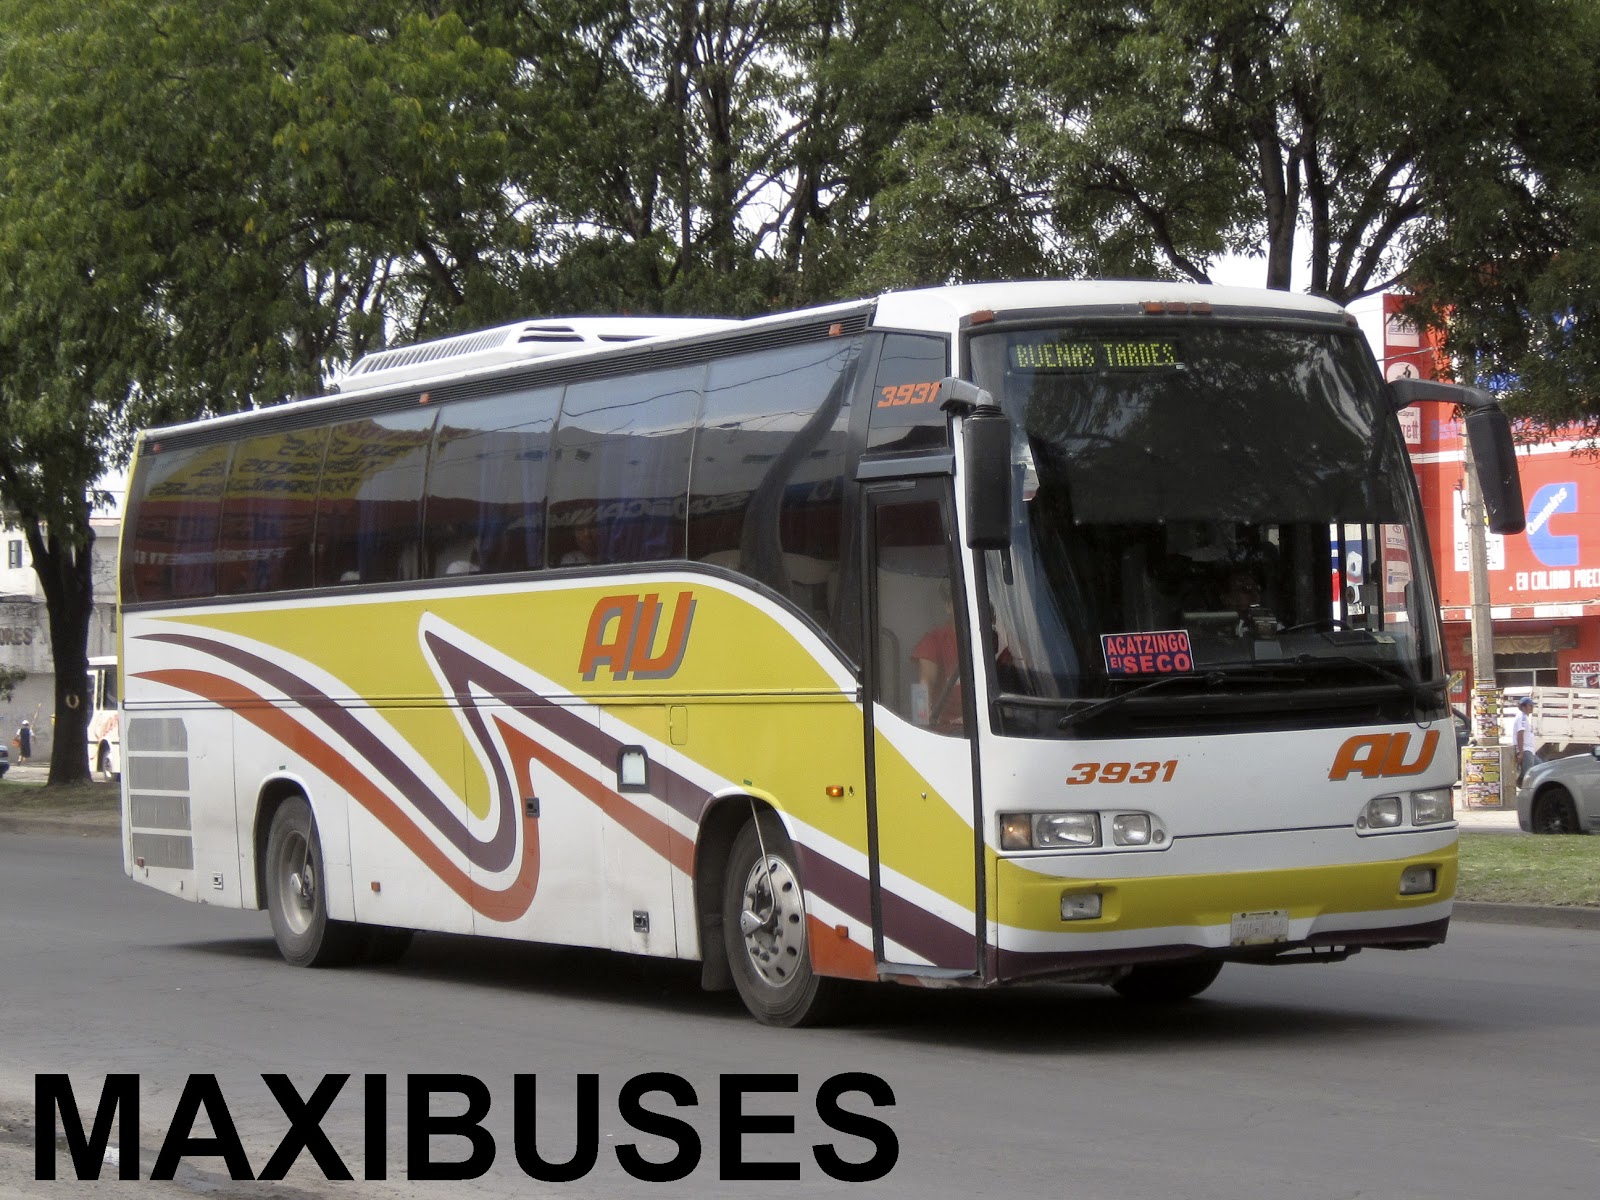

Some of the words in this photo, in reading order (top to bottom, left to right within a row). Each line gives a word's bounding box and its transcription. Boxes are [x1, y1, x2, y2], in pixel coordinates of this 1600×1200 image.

[1016, 344, 1095, 368] BUENAS
[1103, 343, 1175, 366] TARDES
[877, 381, 941, 408] 3931
[1457, 540, 1500, 551] DEOIT
[578, 591, 698, 681] AU
[1107, 633, 1188, 656] ACATZINGO
[1123, 653, 1190, 674] SECO
[1328, 730, 1440, 781] AU
[1066, 760, 1178, 785] 3931
